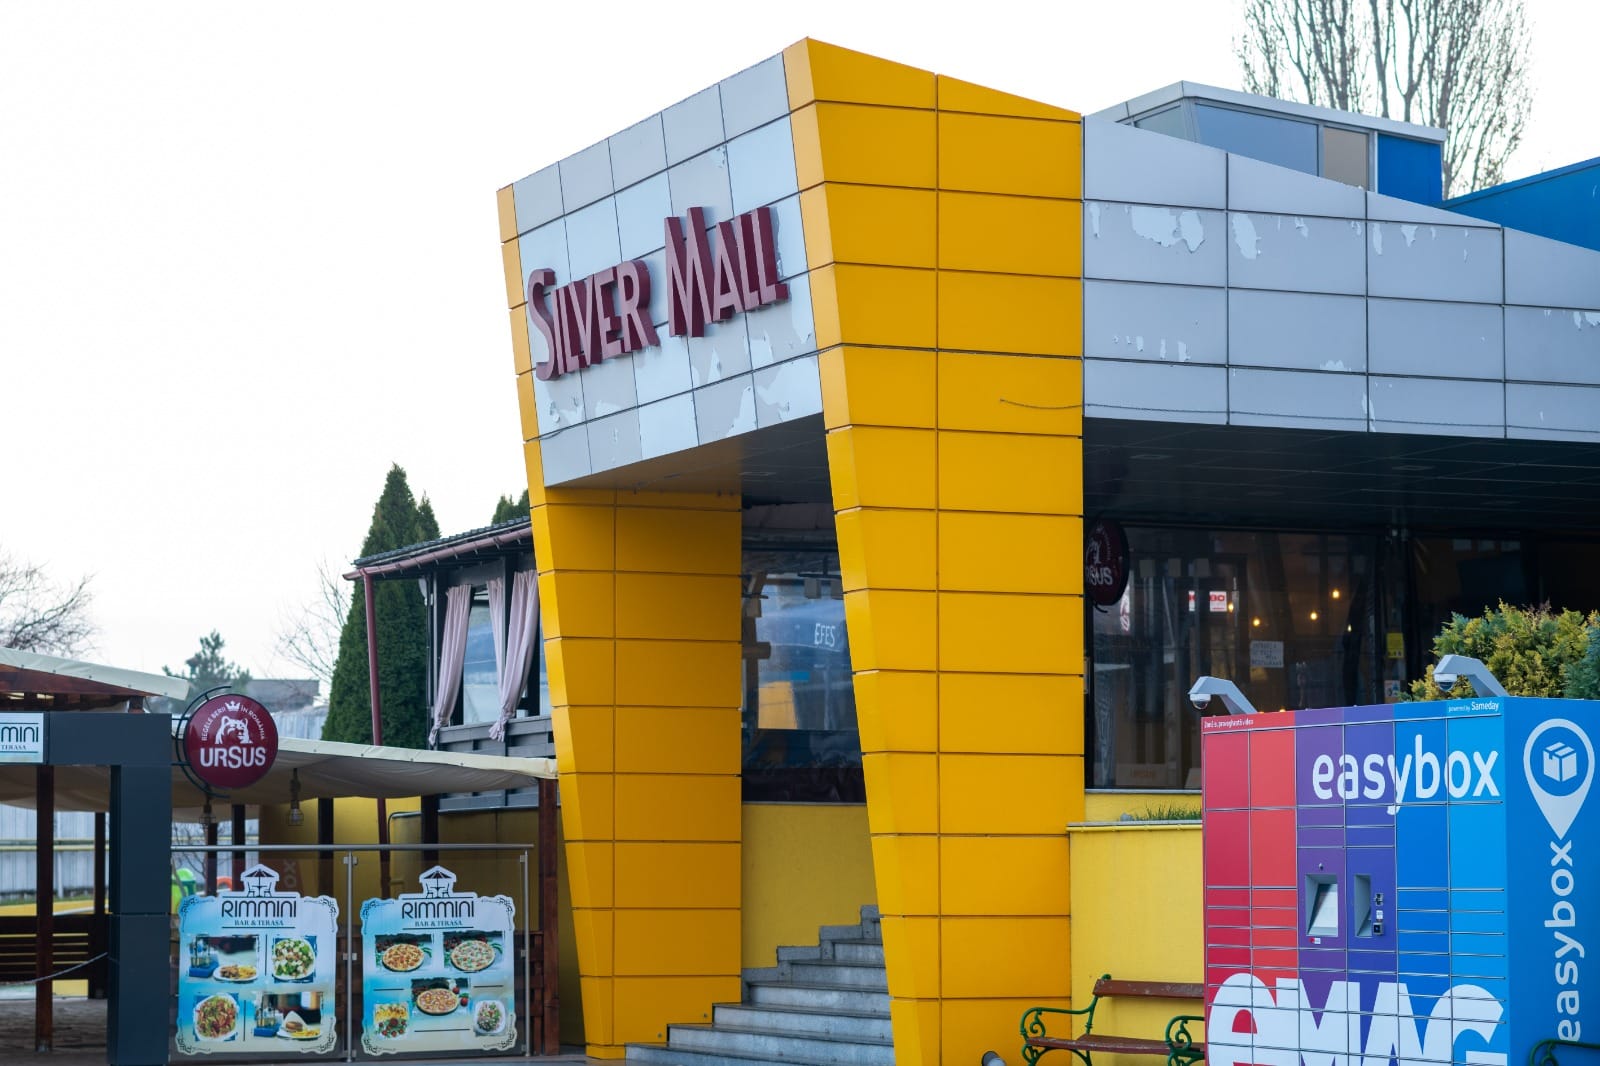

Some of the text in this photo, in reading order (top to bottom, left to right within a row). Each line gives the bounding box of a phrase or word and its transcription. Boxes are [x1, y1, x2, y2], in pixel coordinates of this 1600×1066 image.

[814, 623, 836, 648] EFES
[1471, 701, 1499, 712] Sameday
[200, 746, 266, 768] URSUS
[1312, 734, 1500, 815] easybox
[221, 900, 297, 918] RIMMINI
[401, 900, 475, 919] RIMMINI
[1544, 840, 1585, 1042] easybox
